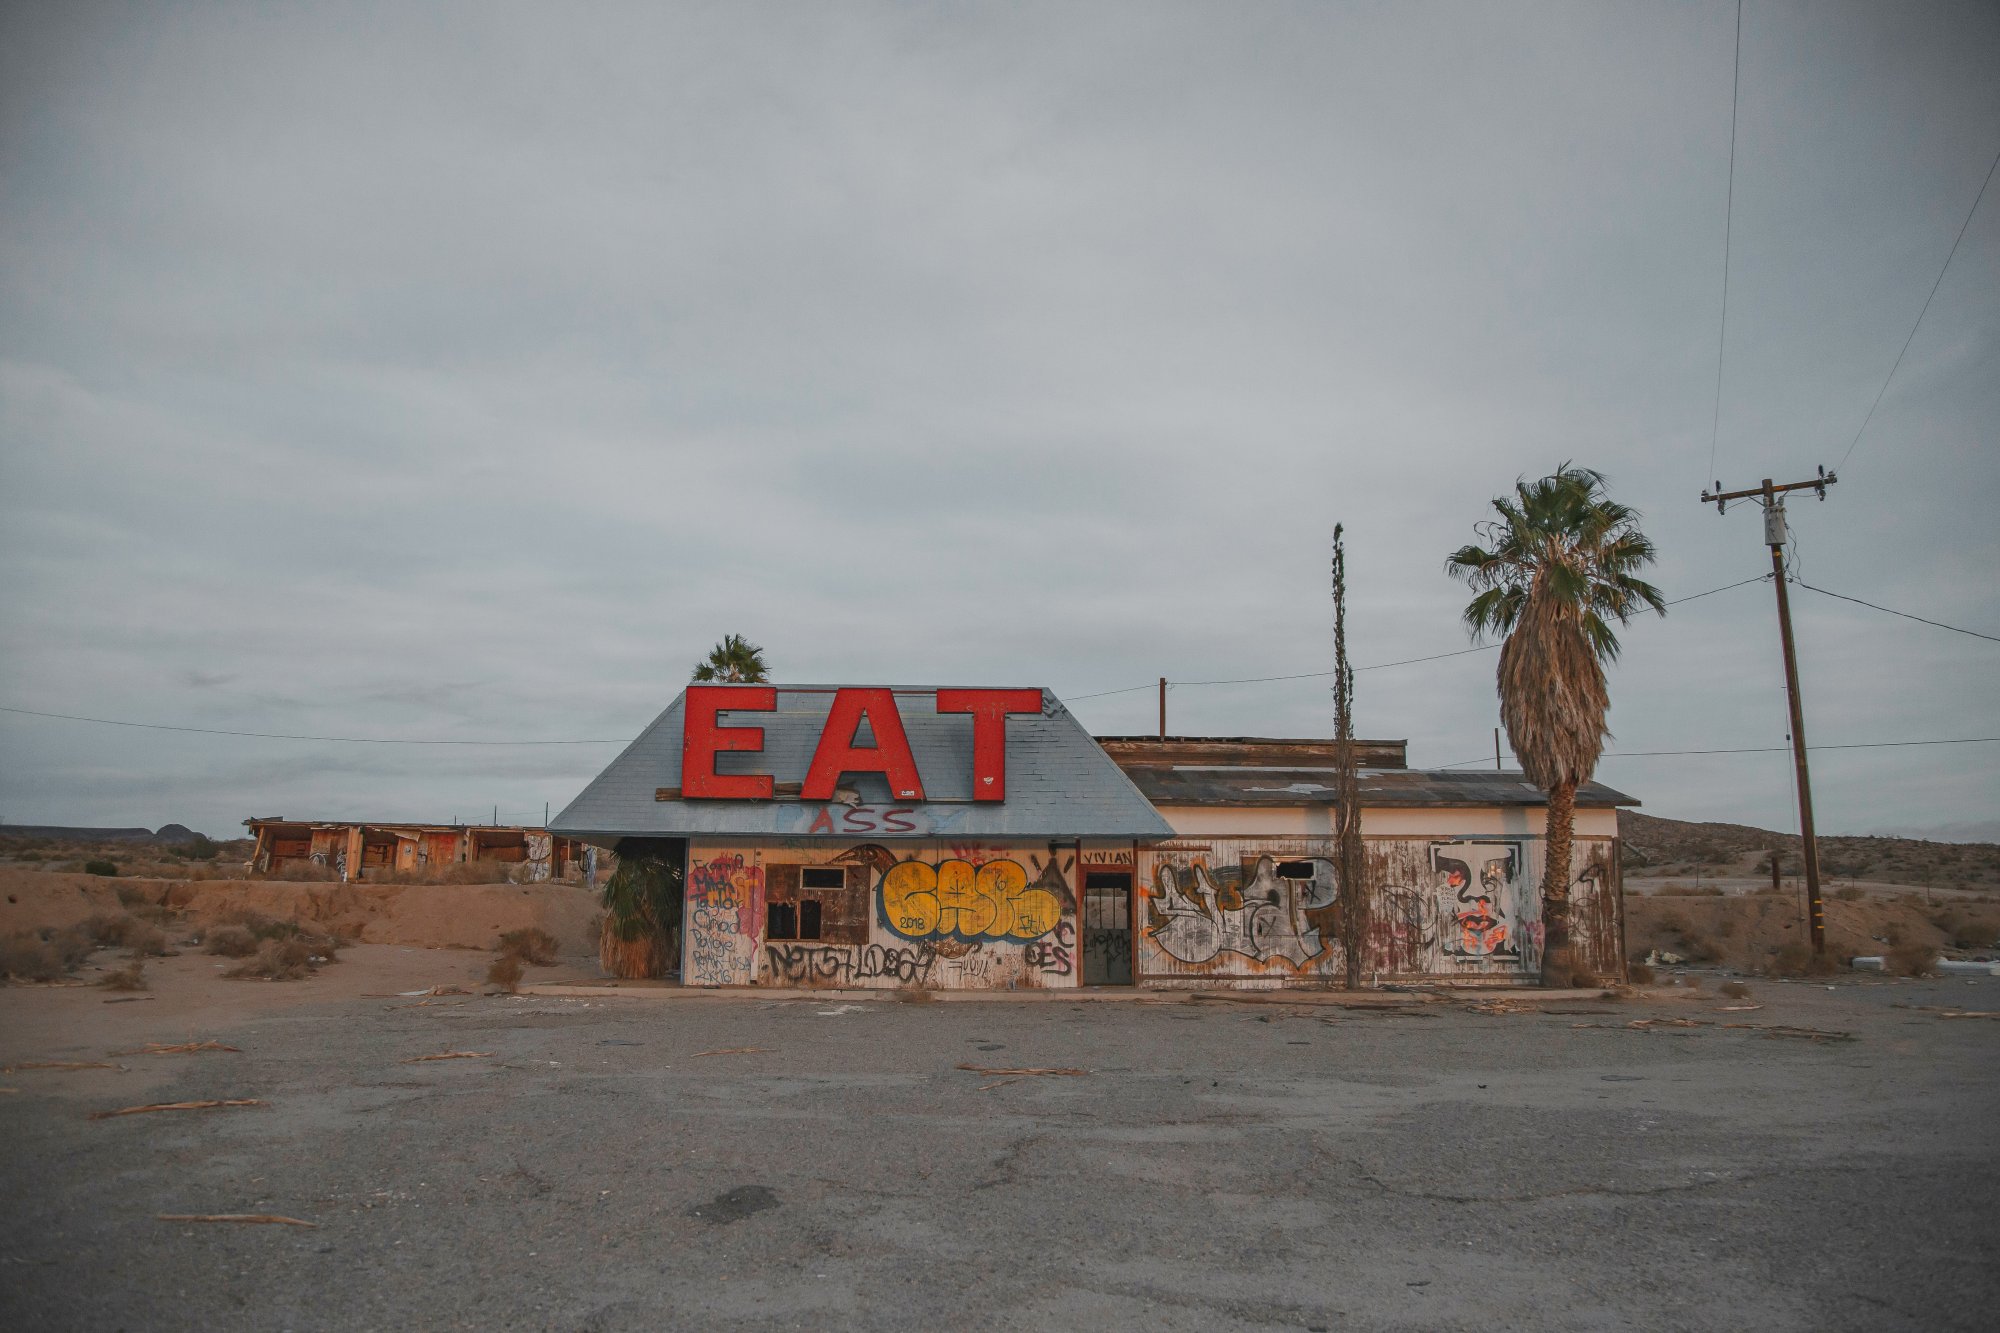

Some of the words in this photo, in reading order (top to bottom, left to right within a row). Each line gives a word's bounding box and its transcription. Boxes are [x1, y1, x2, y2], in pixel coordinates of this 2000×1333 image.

[681, 686, 1043, 802] EAT
[1084, 851, 1133, 865] VIVIAN
[900, 916, 925, 930] 2018
